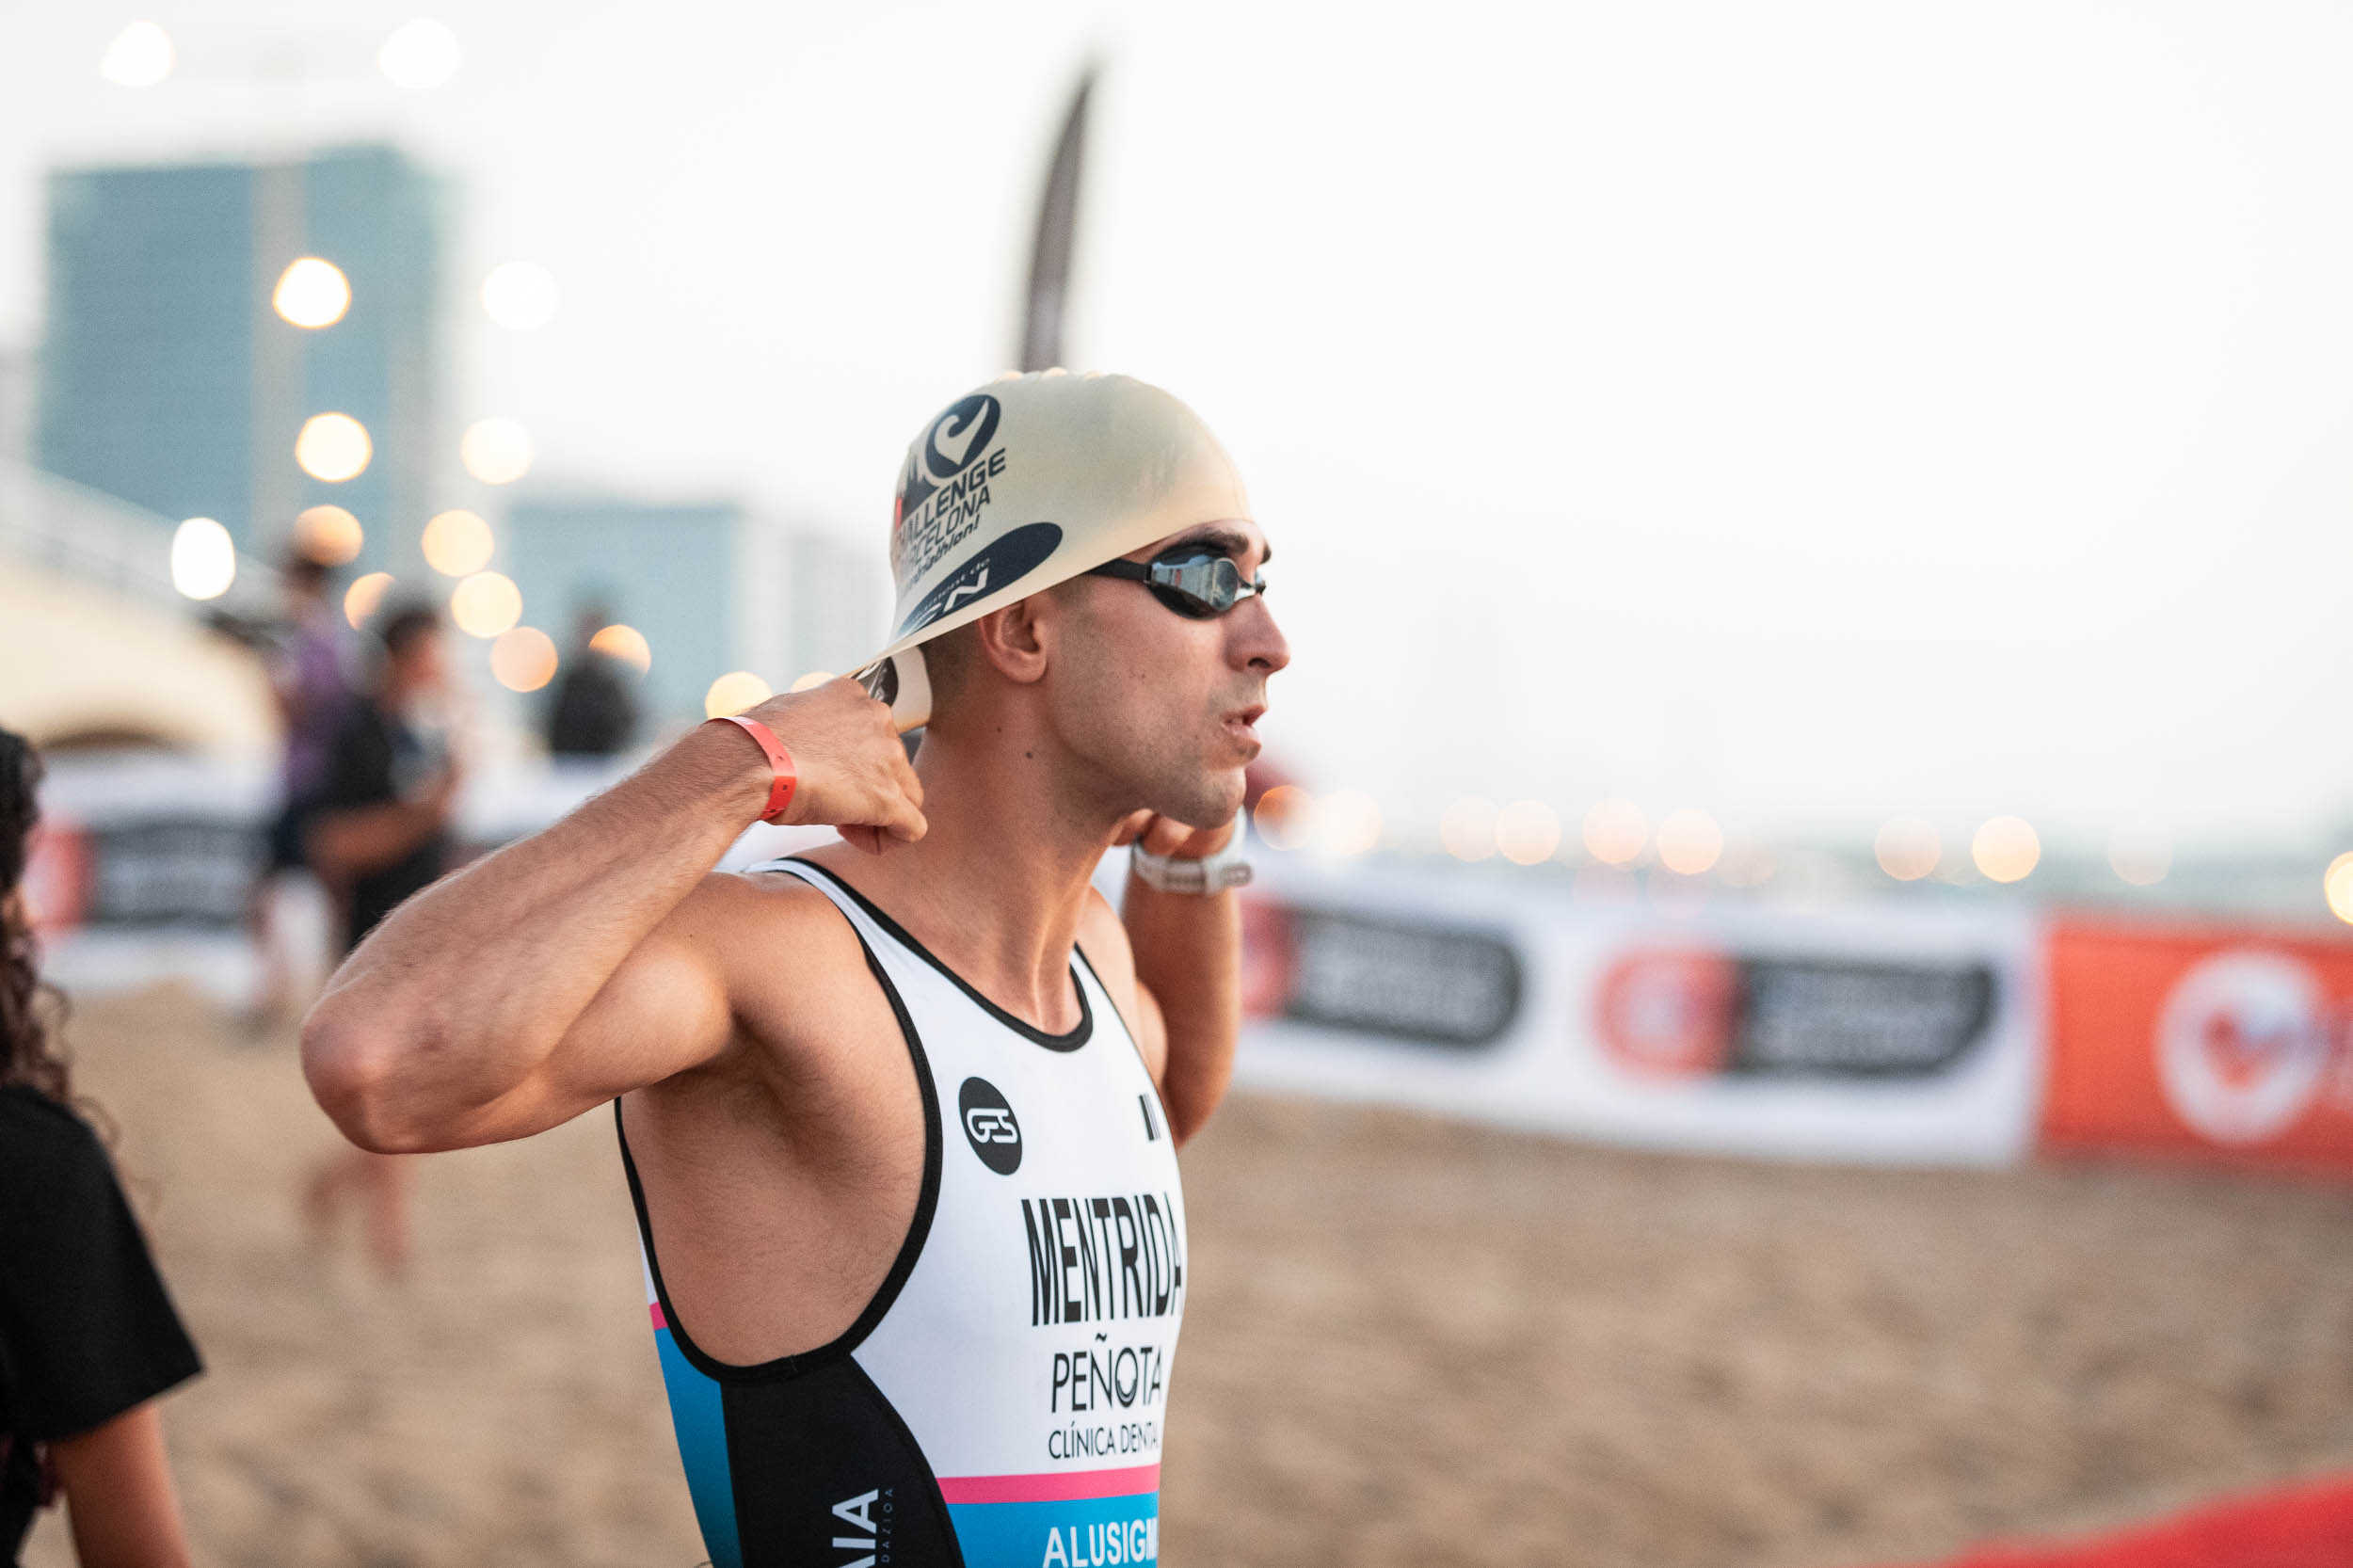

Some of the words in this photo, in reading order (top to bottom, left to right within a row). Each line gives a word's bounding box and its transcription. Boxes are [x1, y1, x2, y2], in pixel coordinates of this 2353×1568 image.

[1020, 1192, 1181, 1326] MENTRIDA
[1051, 1333, 1161, 1413] PEÑOTA
[1048, 1420, 1116, 1459] CLÍNICA
